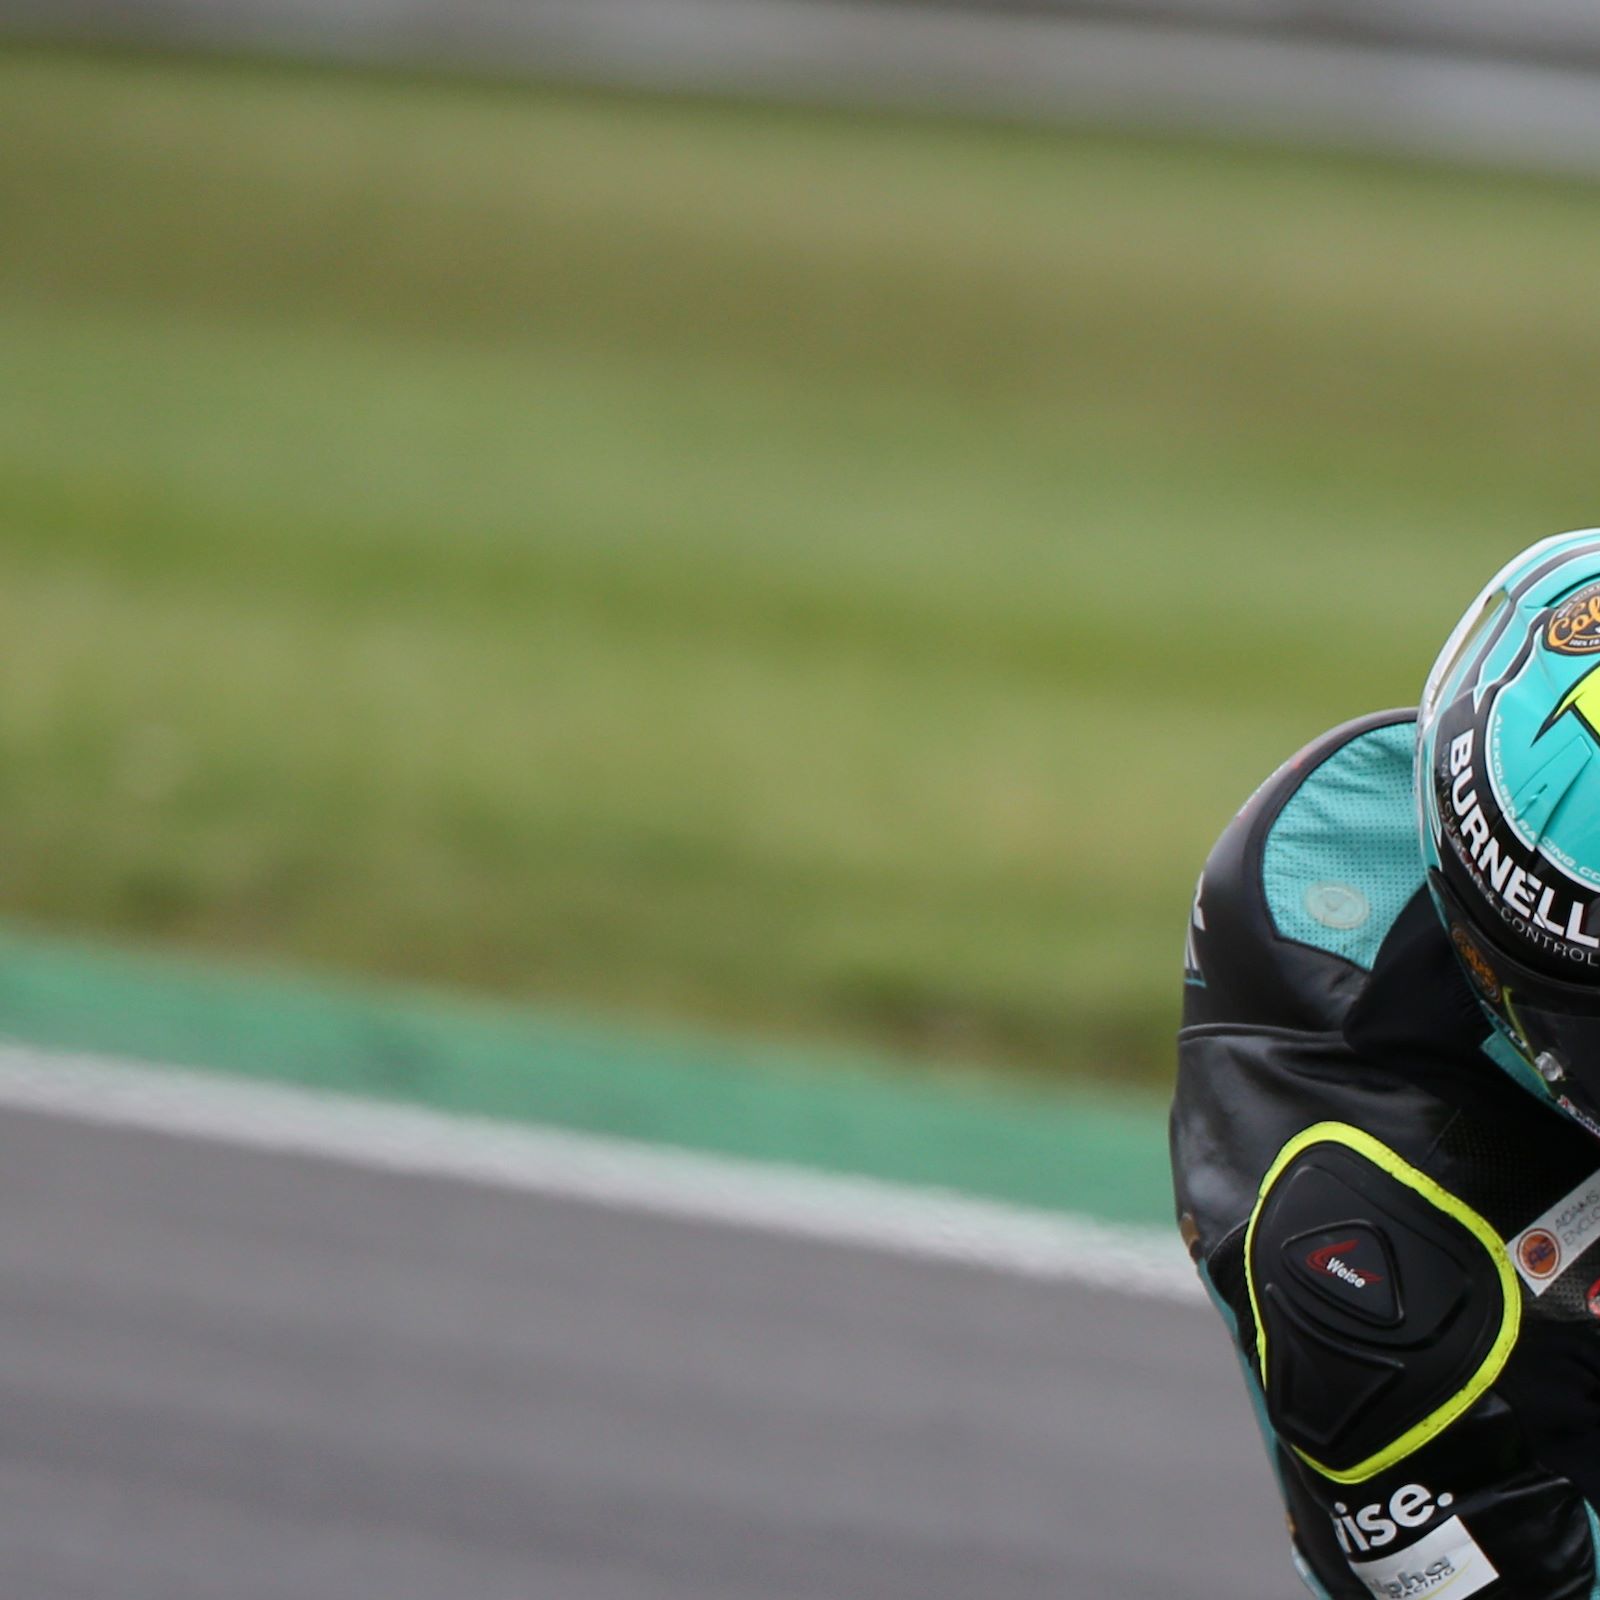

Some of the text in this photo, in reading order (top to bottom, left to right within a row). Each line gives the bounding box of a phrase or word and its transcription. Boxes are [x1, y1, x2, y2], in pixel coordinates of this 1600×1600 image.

[1449, 729, 1599, 949] BURNELL
[1500, 907, 1599, 967] CONTROL
[1326, 1256, 1366, 1289] Weise
